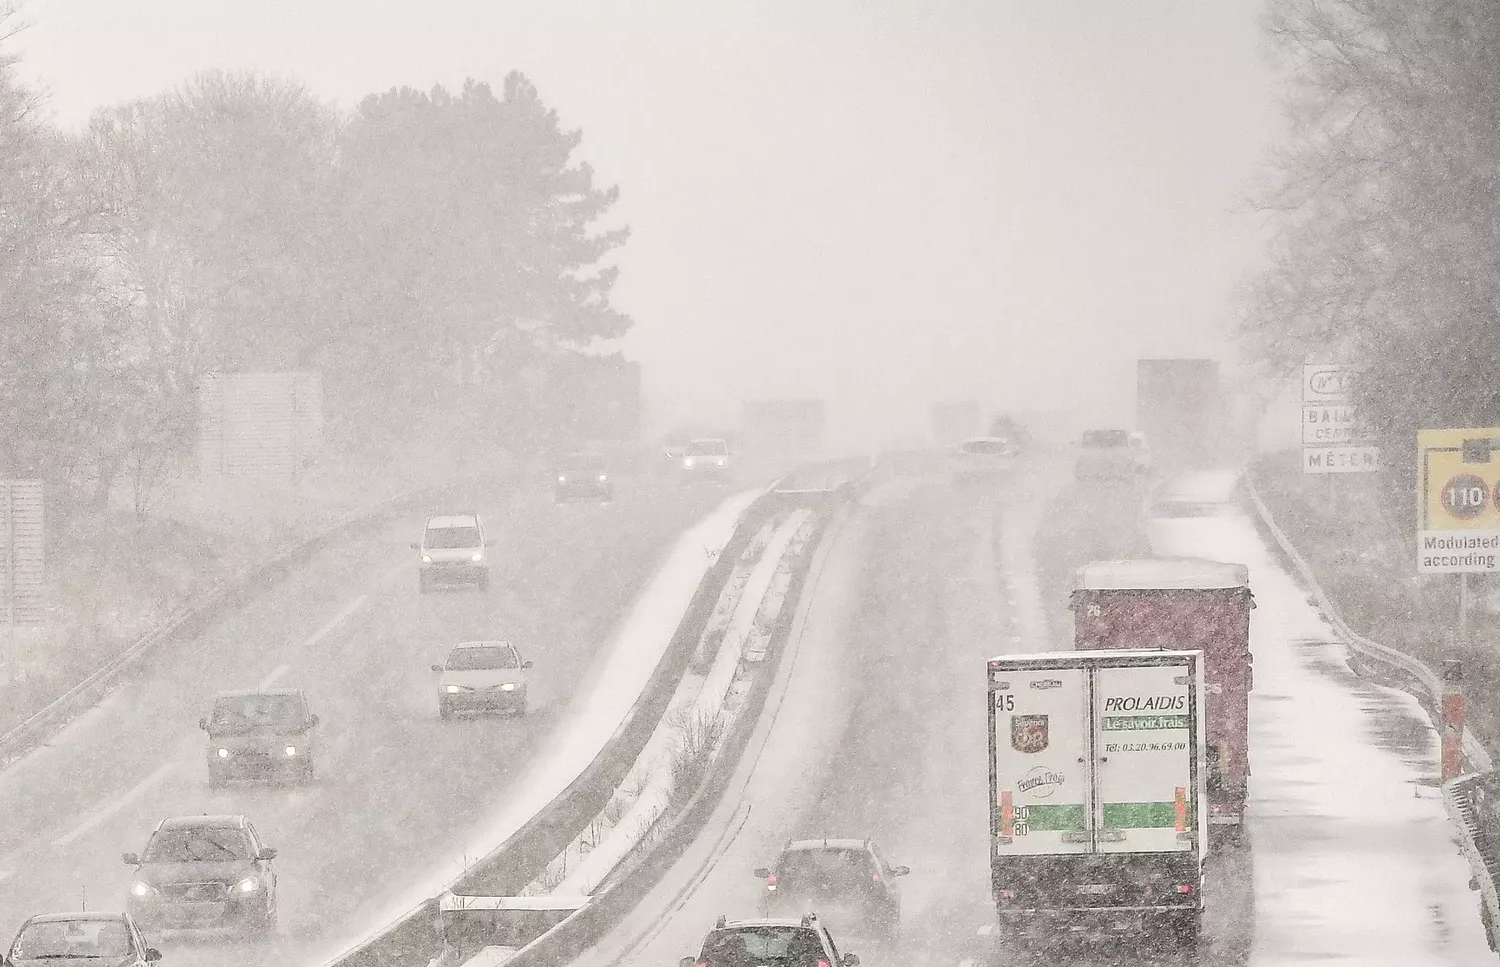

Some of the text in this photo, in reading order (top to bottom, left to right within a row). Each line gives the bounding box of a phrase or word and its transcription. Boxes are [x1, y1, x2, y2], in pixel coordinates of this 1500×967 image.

[1448, 487, 1483, 506] 110
[1424, 536, 1498, 550] Modulated
[1424, 553, 1495, 568] according
[997, 695, 1015, 712] 45
[1105, 696, 1185, 711] PROLAIDIS
[1014, 806, 1028, 820] 90
[1014, 823, 1028, 836] 80
